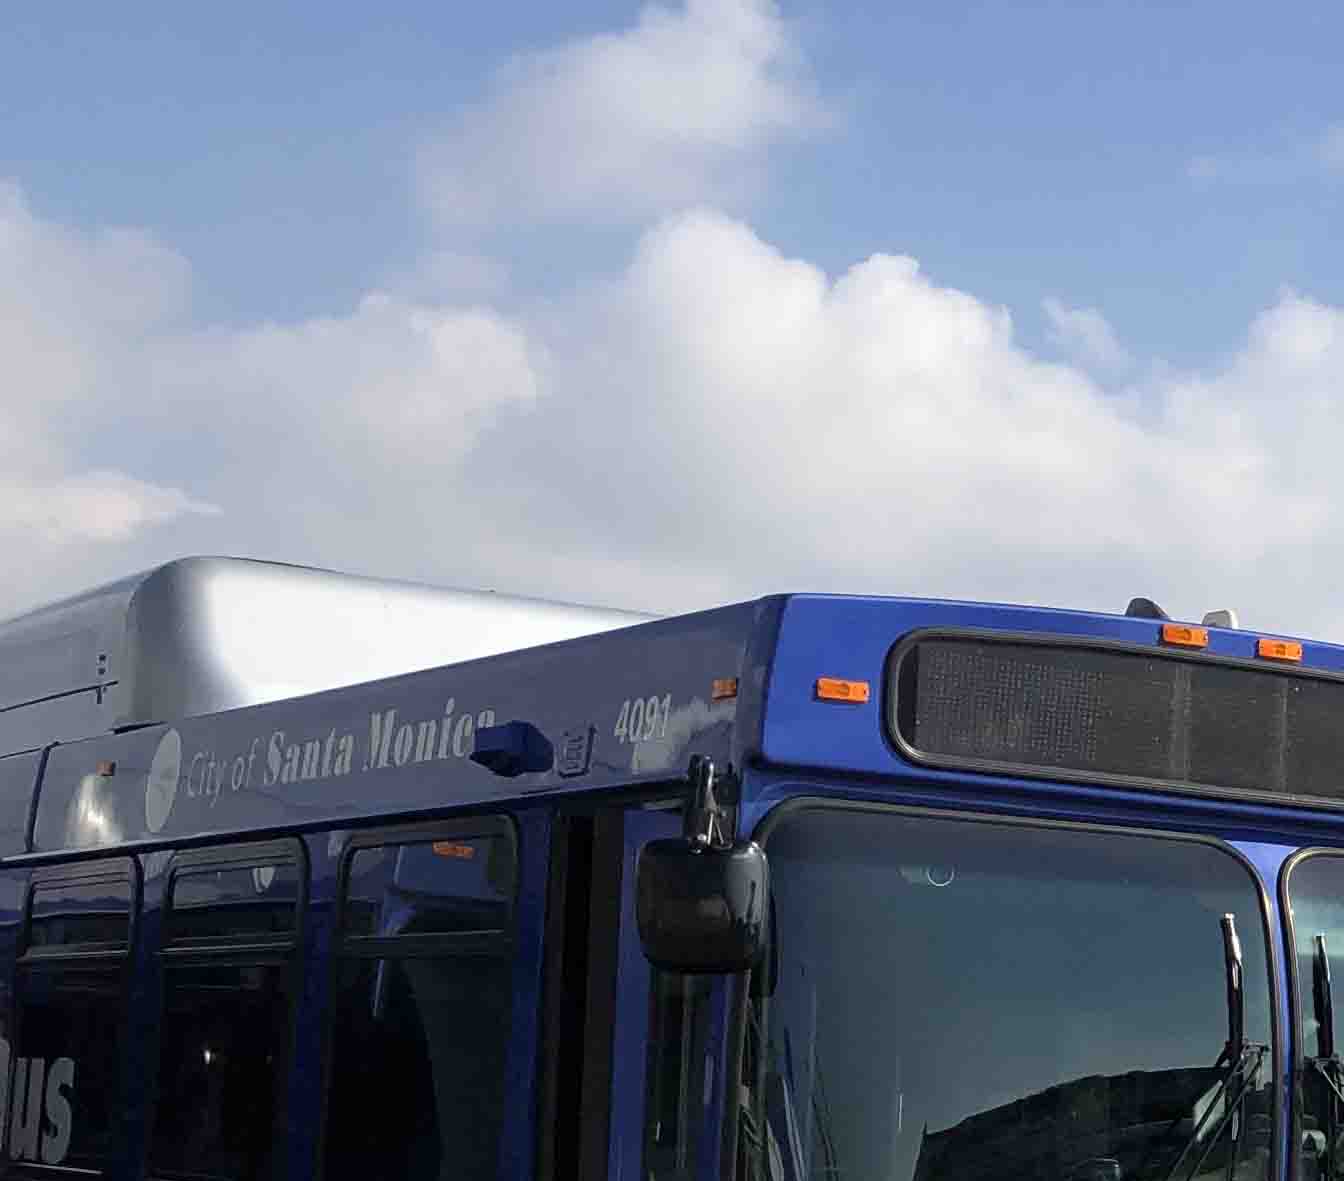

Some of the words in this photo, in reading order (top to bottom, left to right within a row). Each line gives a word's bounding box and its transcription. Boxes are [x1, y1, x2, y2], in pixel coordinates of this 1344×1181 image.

[614, 693, 671, 744] 4091
[187, 751, 227, 807] City
[231, 737, 264, 791] of
[264, 728, 354, 785] Santa
